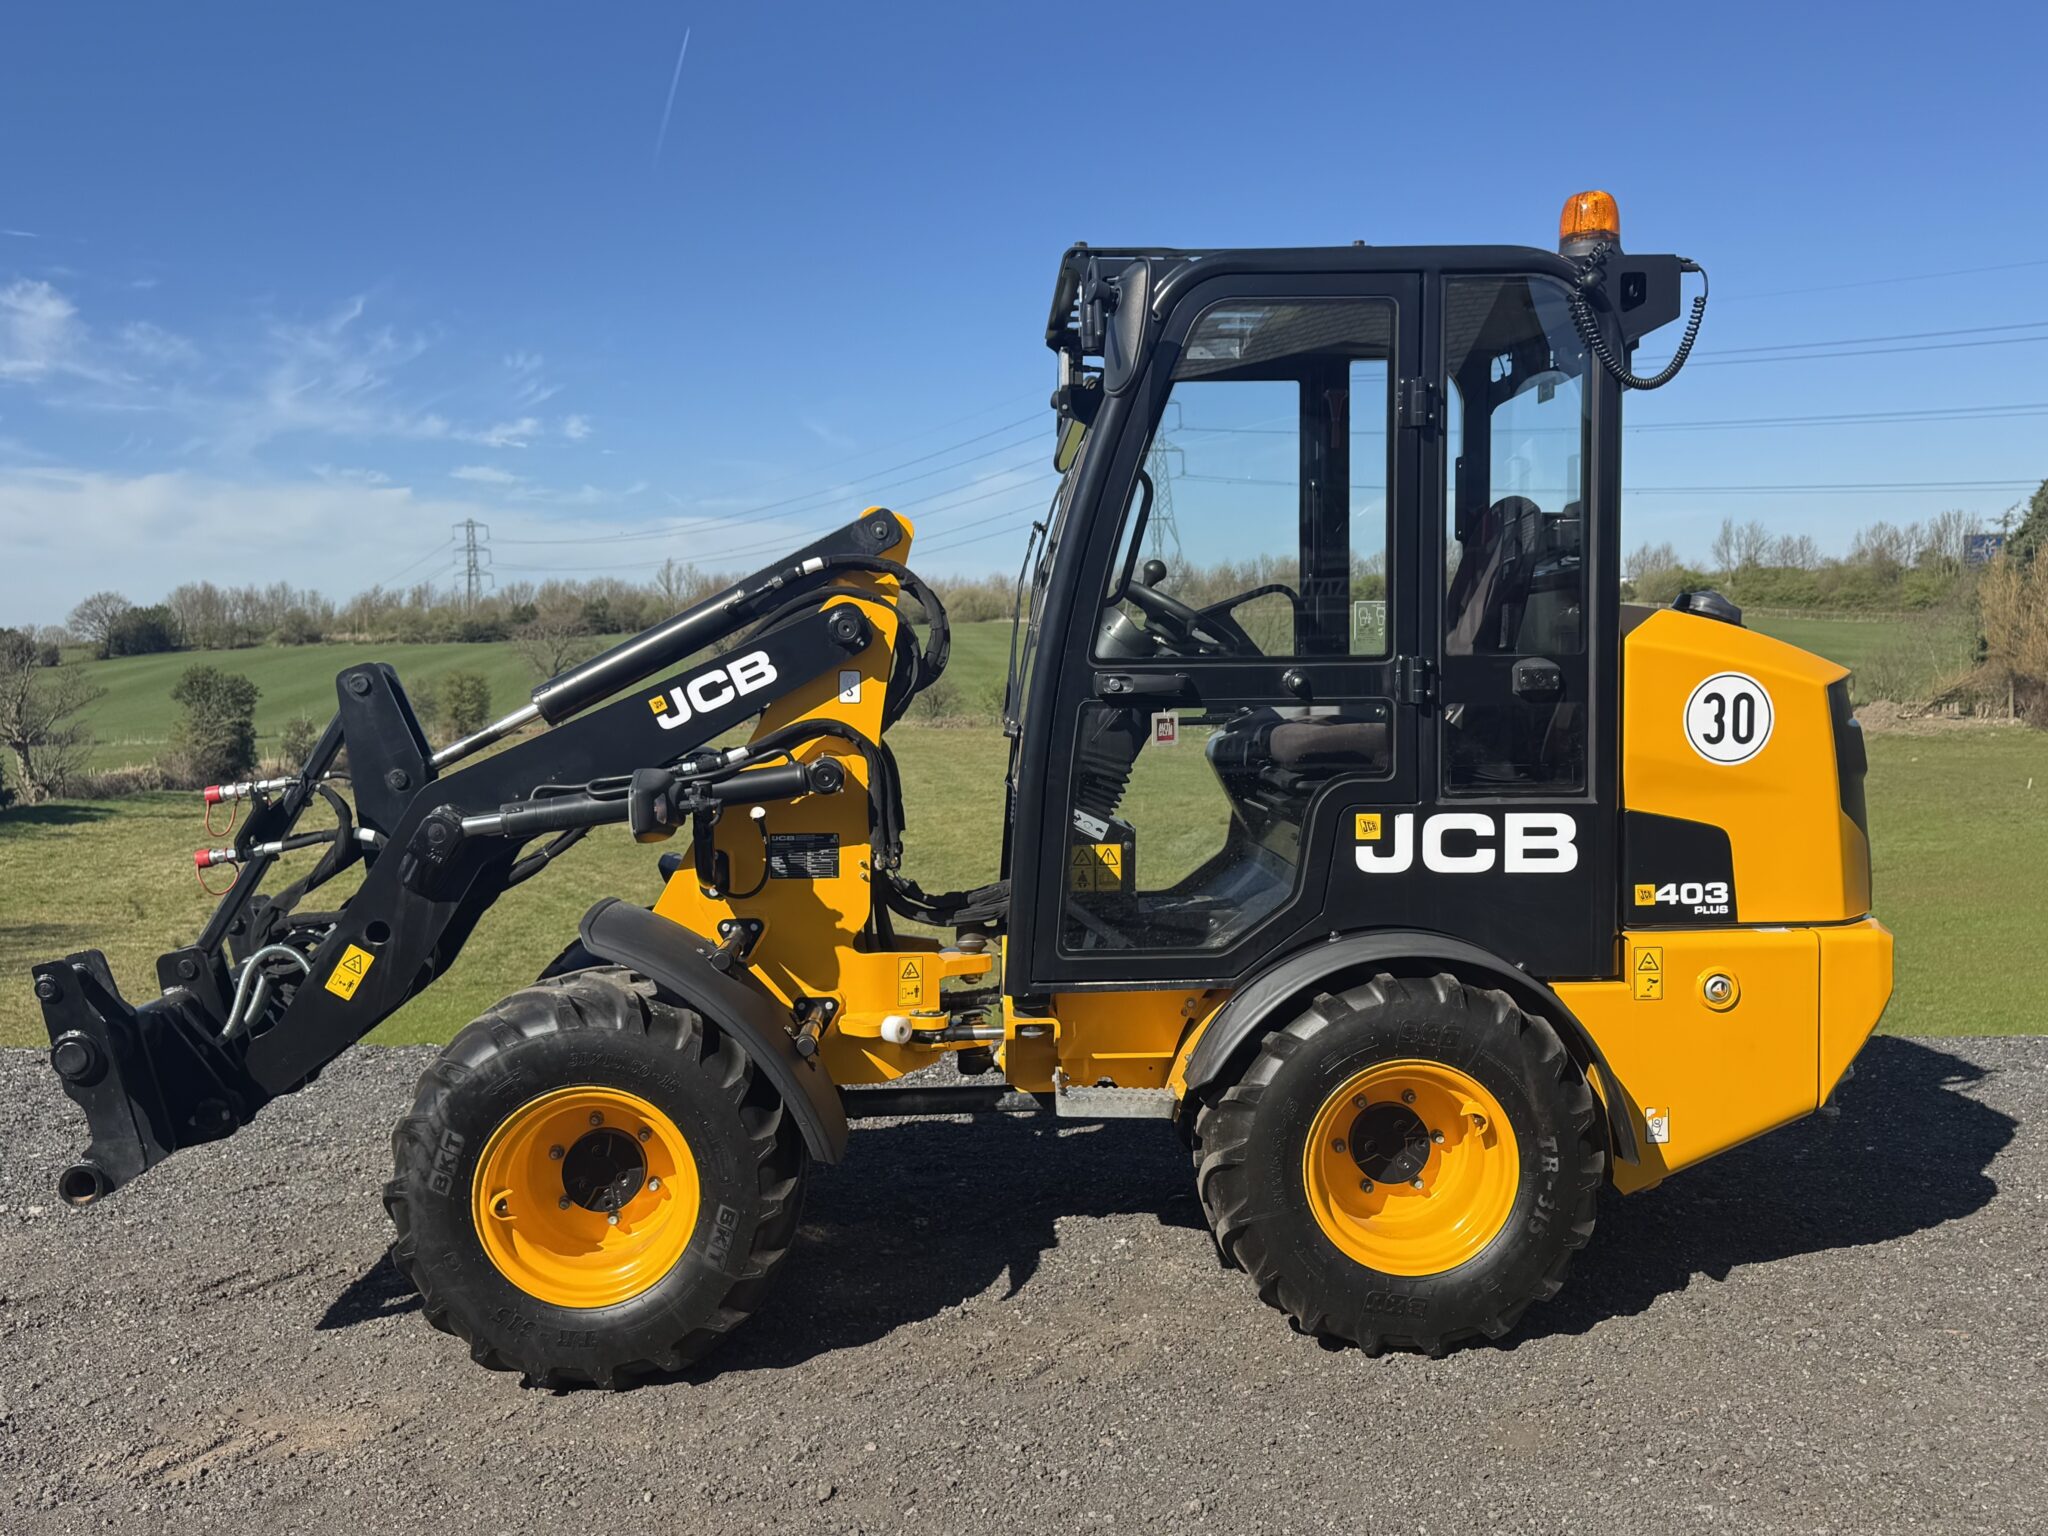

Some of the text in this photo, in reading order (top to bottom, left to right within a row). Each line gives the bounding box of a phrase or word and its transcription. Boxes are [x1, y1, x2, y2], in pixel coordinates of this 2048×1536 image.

[656, 650, 778, 730] JCB
[1702, 691, 1755, 745] 30
[1355, 812, 1579, 874] JCB
[1362, 820, 1377, 833] JCB
[1655, 881, 1729, 905] 403
[1694, 905, 1729, 915] PLUS
[431, 1131, 463, 1195] BKT
[706, 1206, 740, 1272] BKT
